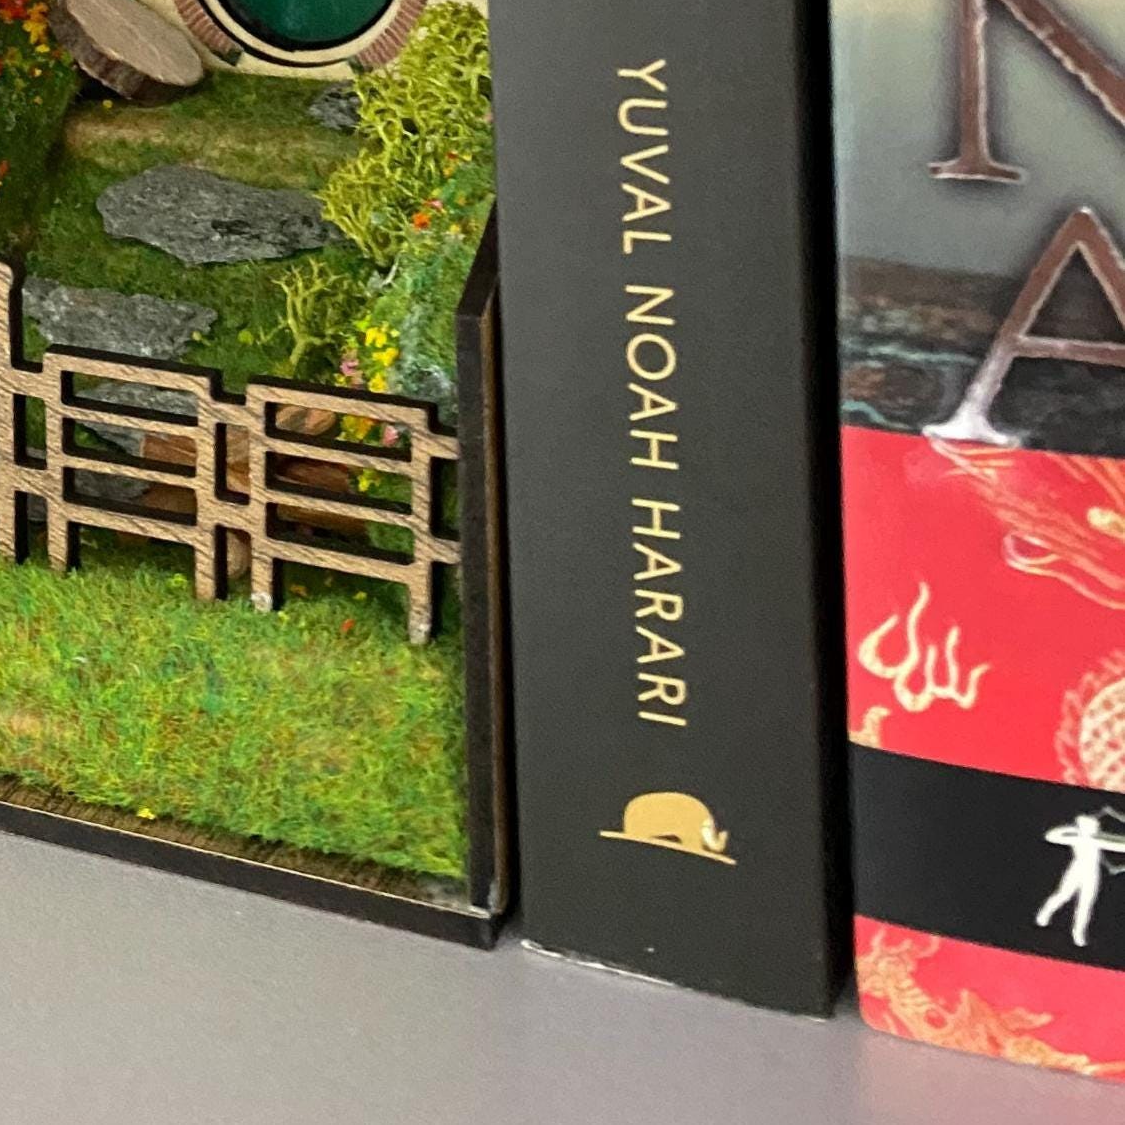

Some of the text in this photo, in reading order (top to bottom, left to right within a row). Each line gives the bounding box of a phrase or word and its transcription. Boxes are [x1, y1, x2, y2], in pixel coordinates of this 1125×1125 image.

[615, 58, 688, 728] YUVAL NOAH HARARI
